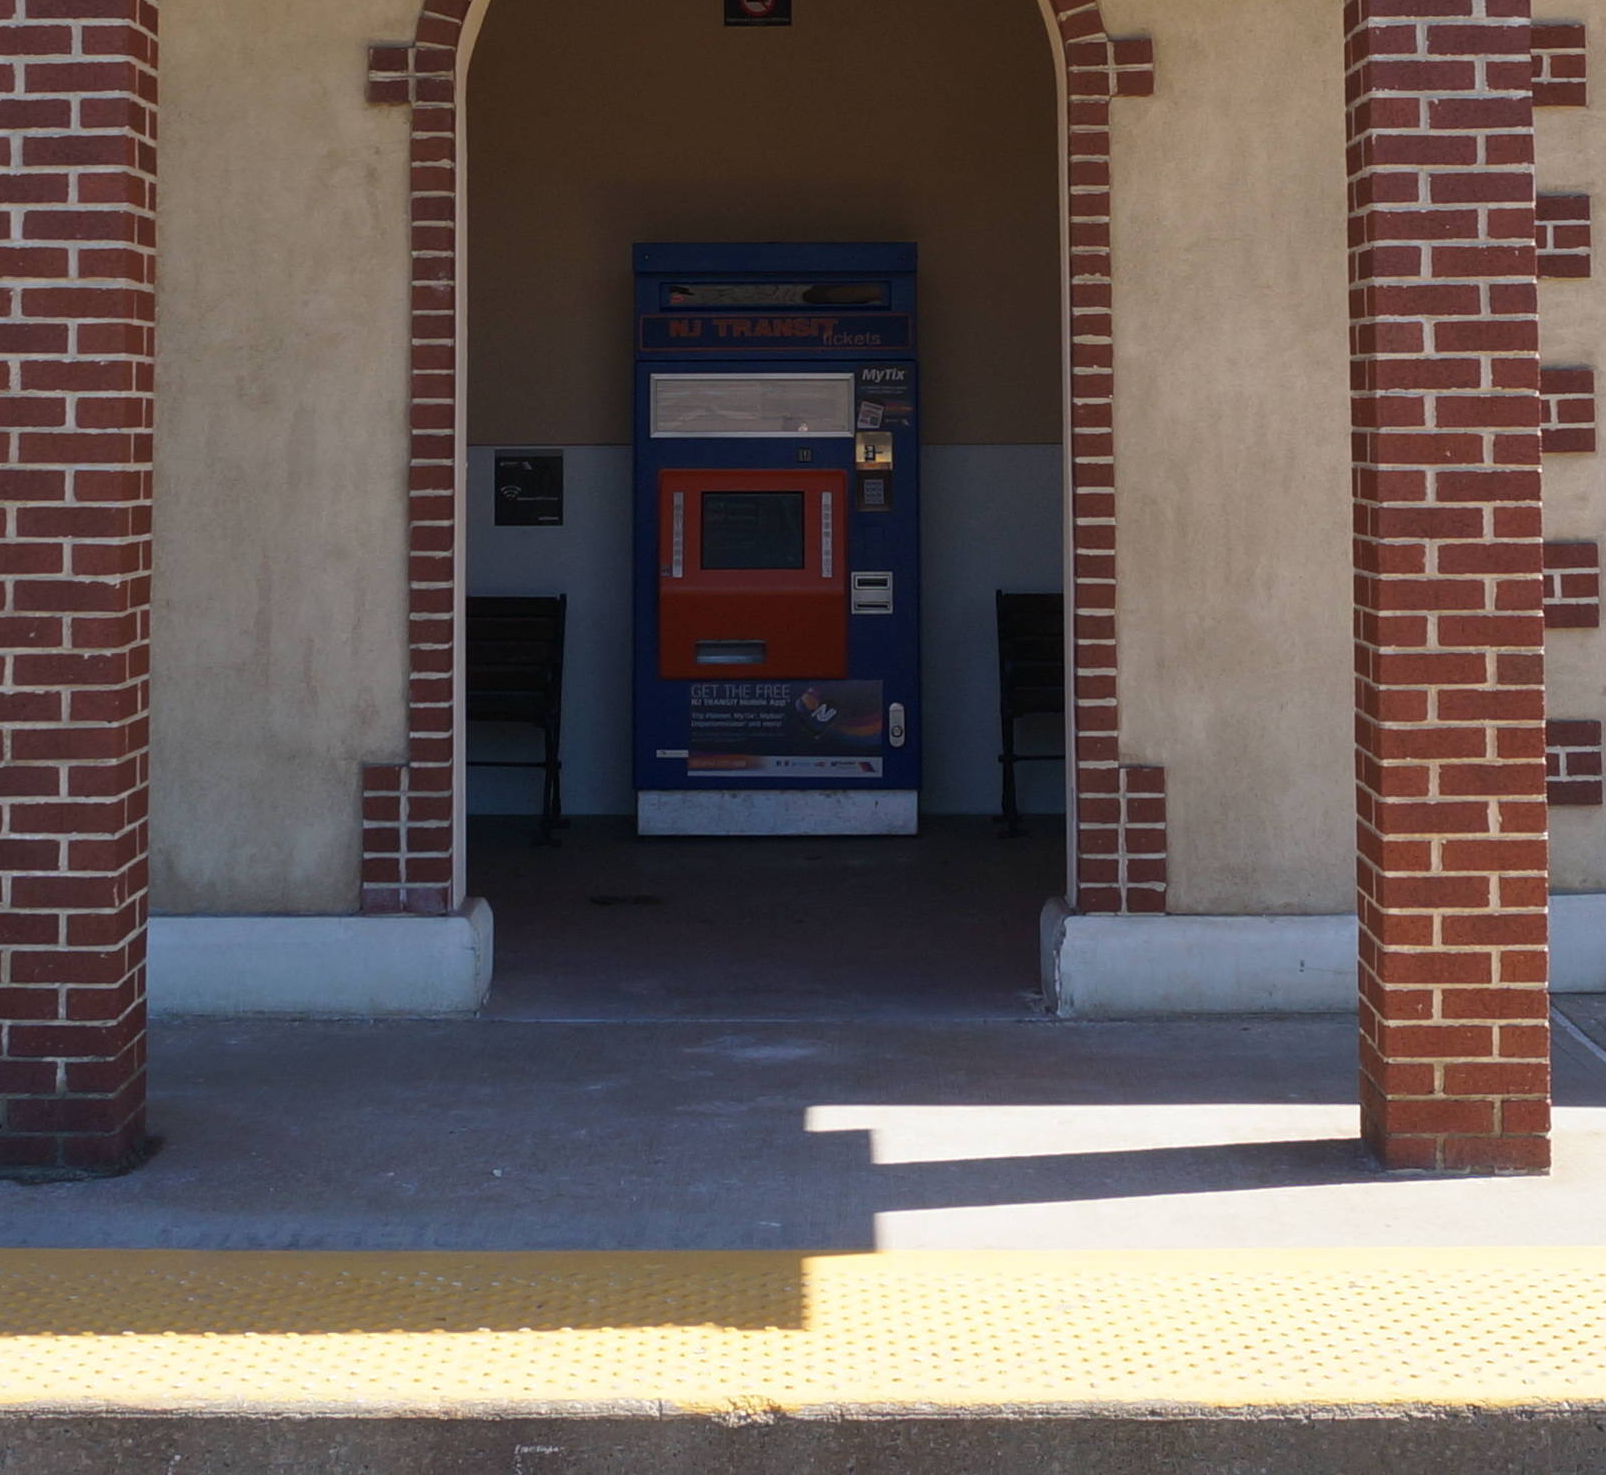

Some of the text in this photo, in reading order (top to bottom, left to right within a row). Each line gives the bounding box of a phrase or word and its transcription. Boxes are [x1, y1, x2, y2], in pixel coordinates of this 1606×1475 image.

[669, 317, 840, 338] NJ TRANSIT
[822, 331, 882, 346] tickets
[861, 368, 905, 384] MyTix
[691, 684, 791, 699] GET THE FREE
